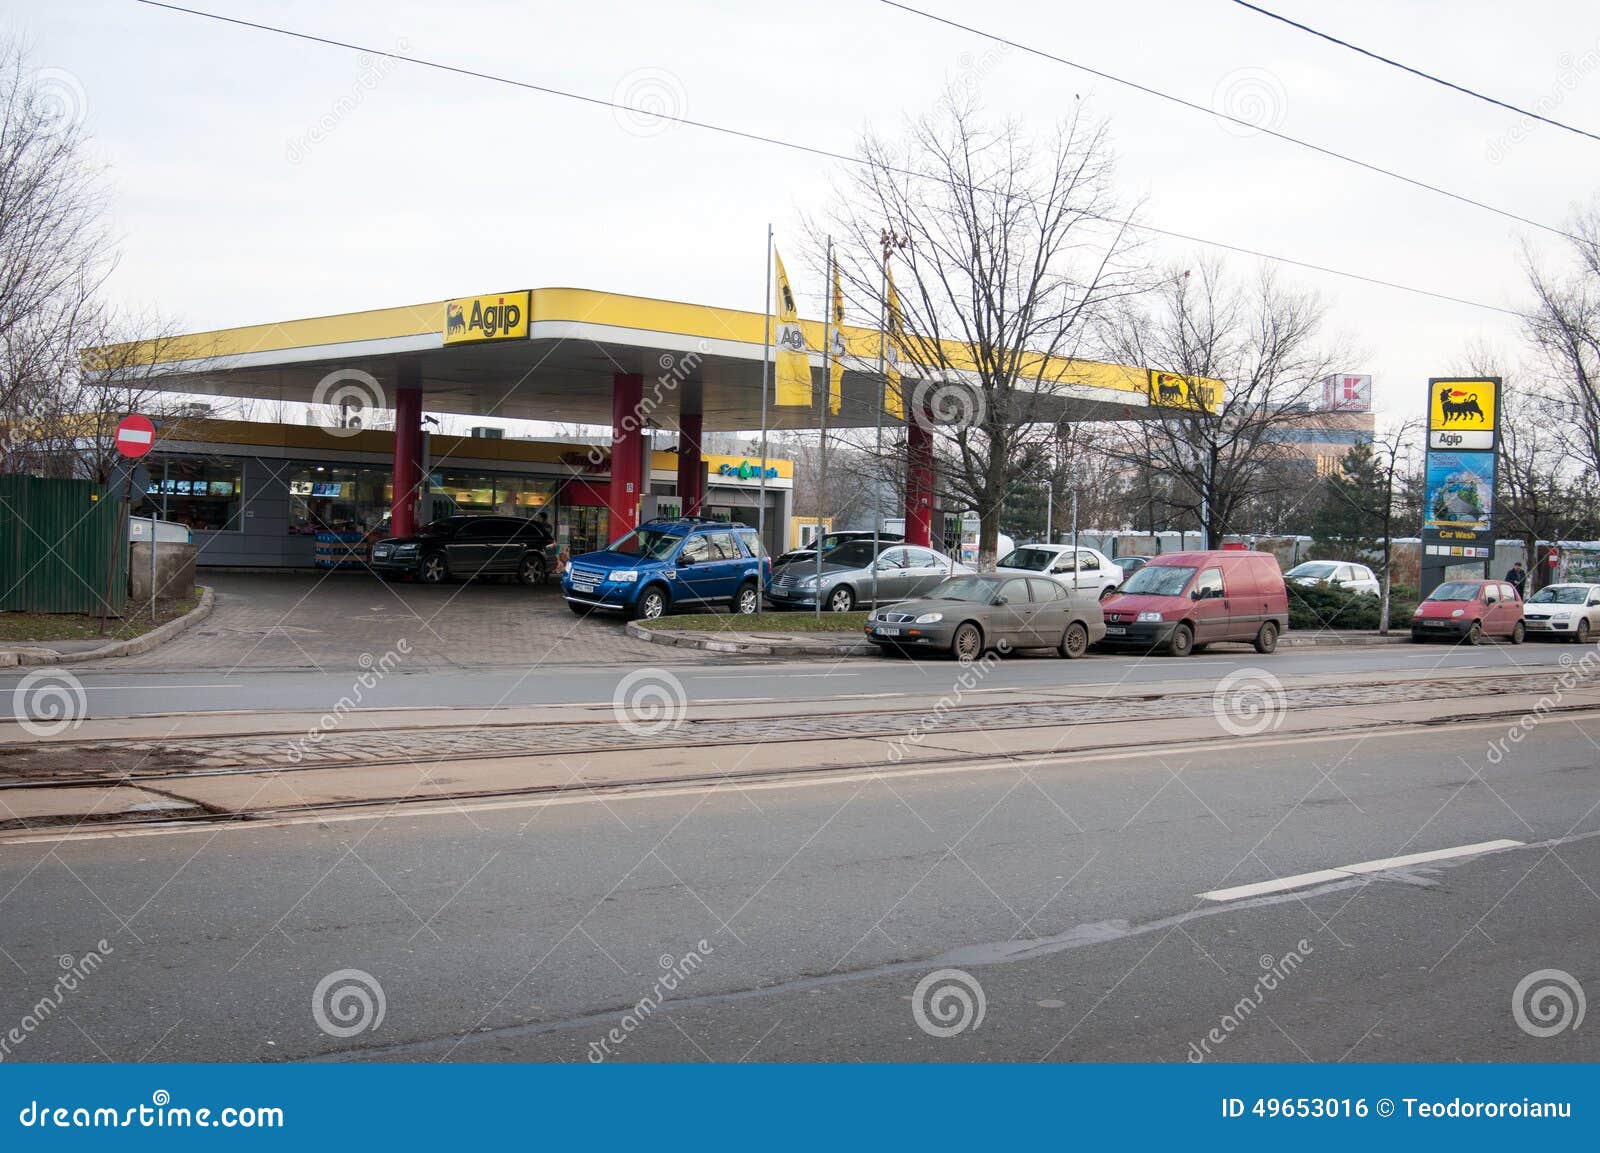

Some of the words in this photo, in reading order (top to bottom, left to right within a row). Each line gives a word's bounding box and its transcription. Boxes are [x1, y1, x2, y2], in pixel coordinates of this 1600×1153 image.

[468, 297, 520, 337] Agip
[1439, 433, 1462, 446] Agip
[751, 465, 778, 478] Wsh
[1439, 530, 1453, 539] Car
[1455, 531, 1476, 540] Wash
